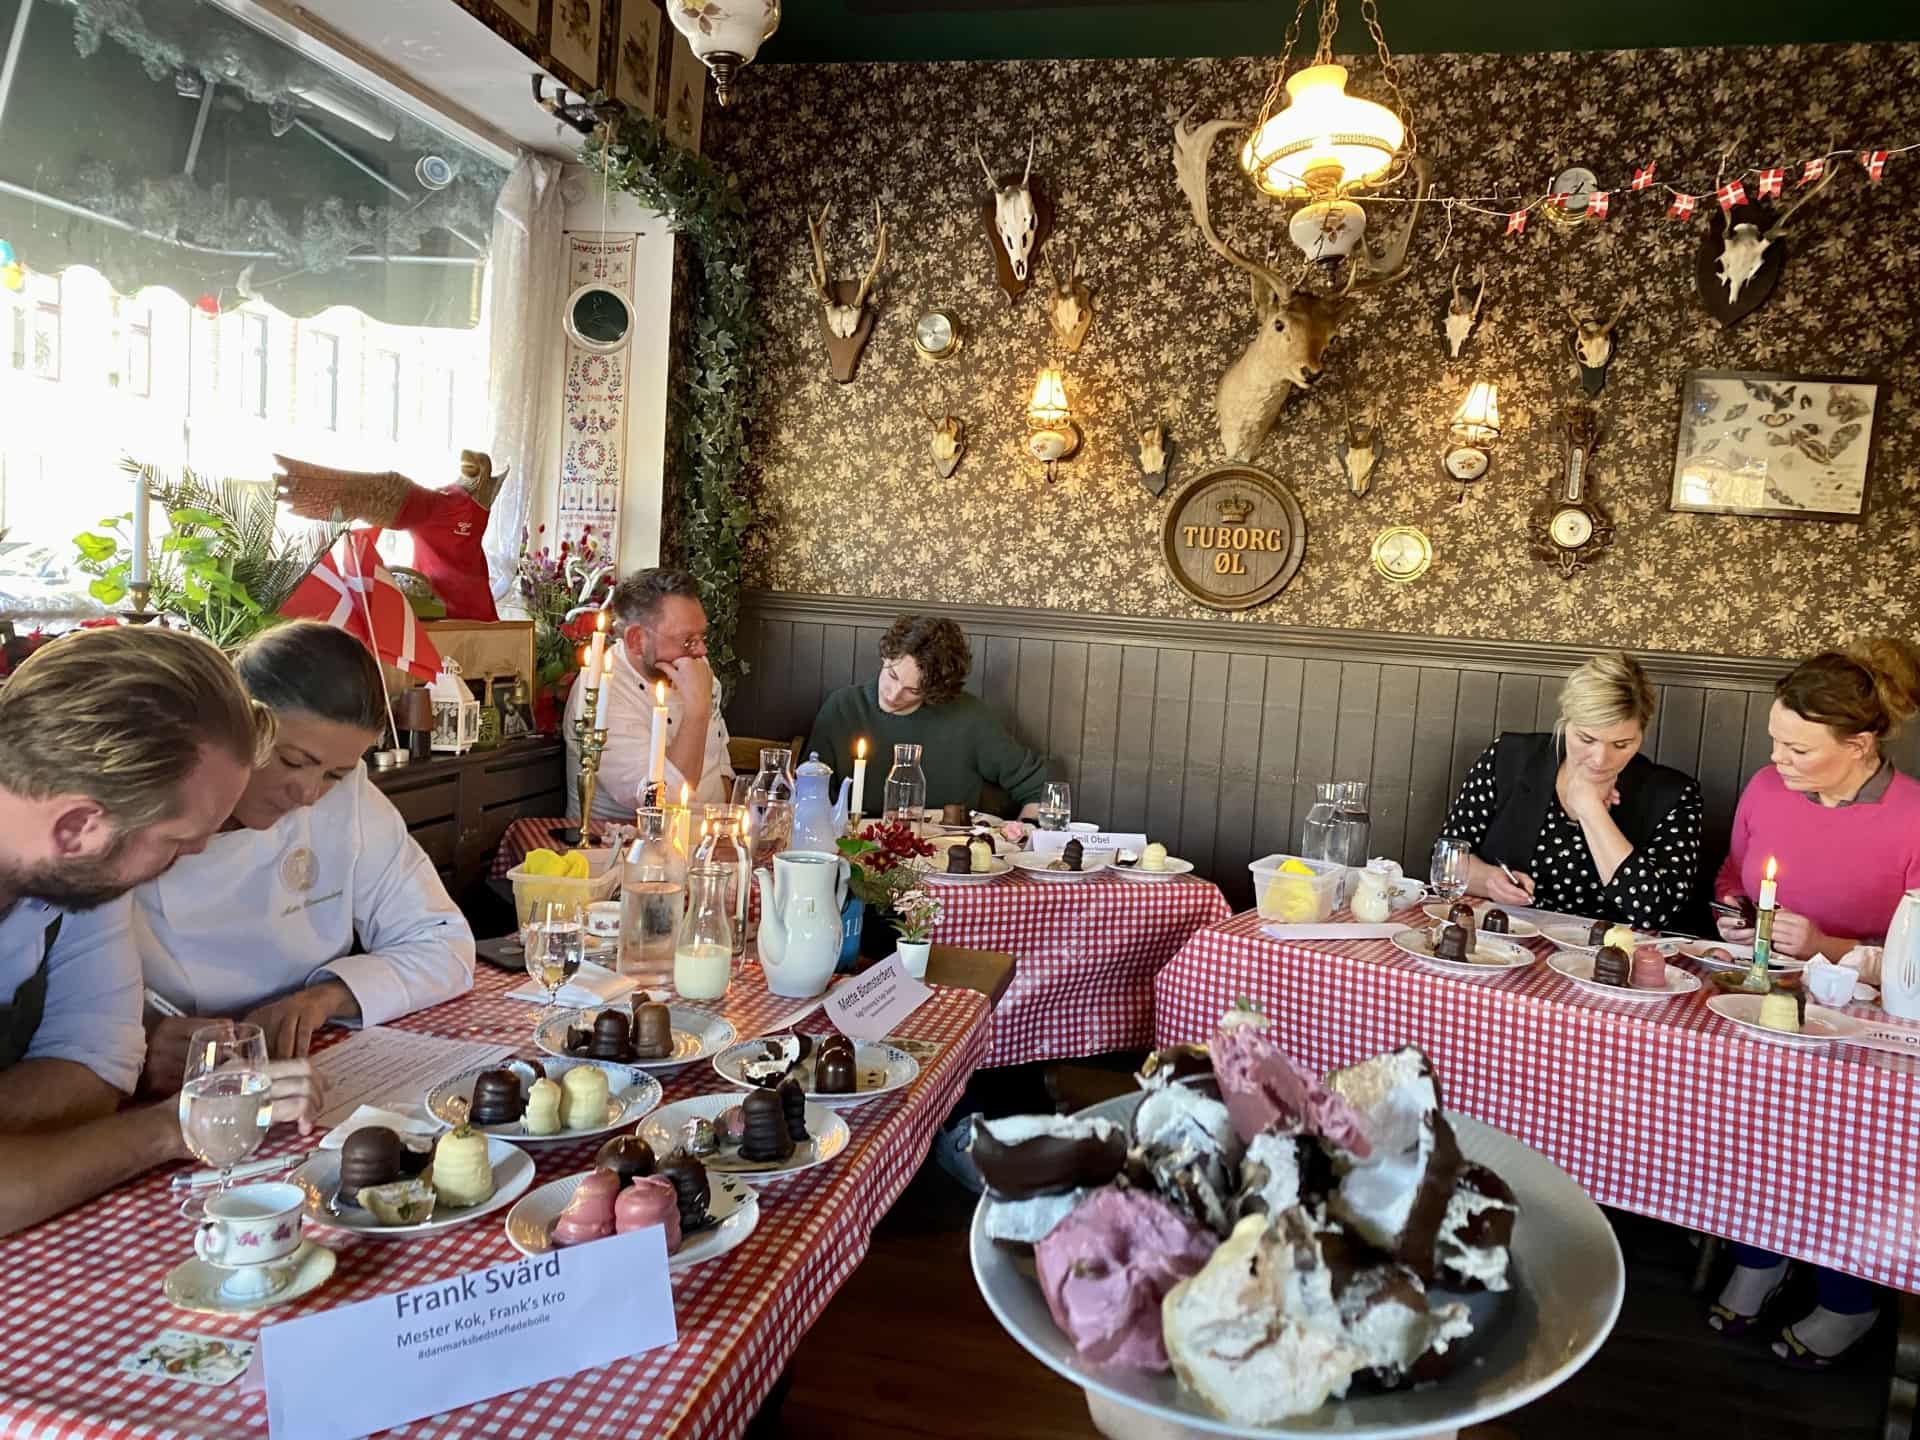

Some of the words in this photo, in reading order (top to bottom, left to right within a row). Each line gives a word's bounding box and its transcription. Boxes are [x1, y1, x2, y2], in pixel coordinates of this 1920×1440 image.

[1184, 525, 1281, 552] TUBORG
[1215, 552, 1246, 575] ØL
[837, 991, 860, 1010] Mette
[856, 965, 897, 999] Blomsterberg
[396, 1274, 477, 1319] Frank
[485, 1251, 561, 1294] Svärd
[396, 1323, 450, 1349] Mester
[454, 1311, 486, 1333] Kok,
[490, 1297, 539, 1320] Frank's
[542, 1290, 566, 1307] Kro
